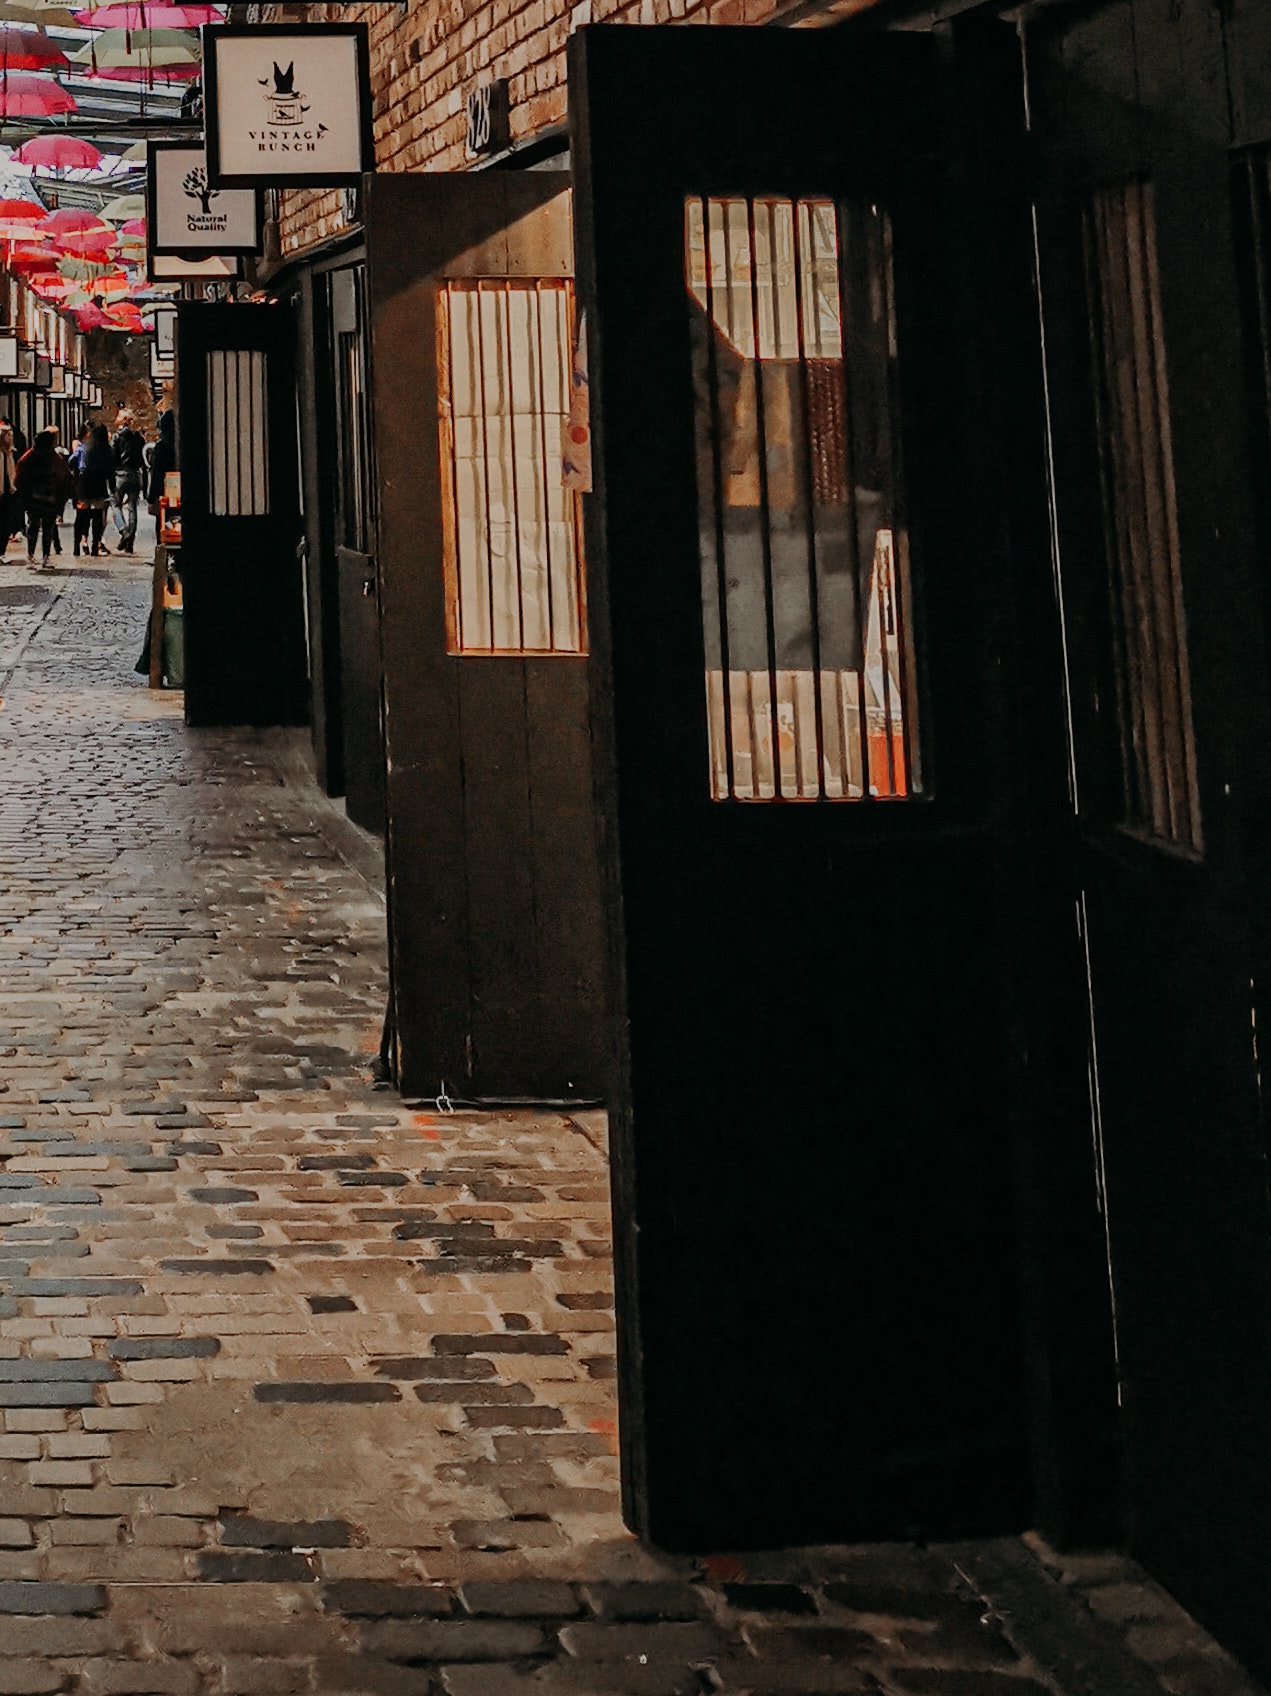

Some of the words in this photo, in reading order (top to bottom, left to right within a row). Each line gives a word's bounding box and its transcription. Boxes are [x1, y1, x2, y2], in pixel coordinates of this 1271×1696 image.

[248, 131, 325, 140] VINTAGE
[187, 214, 228, 223] Natural
[187, 222, 228, 233] Quality
